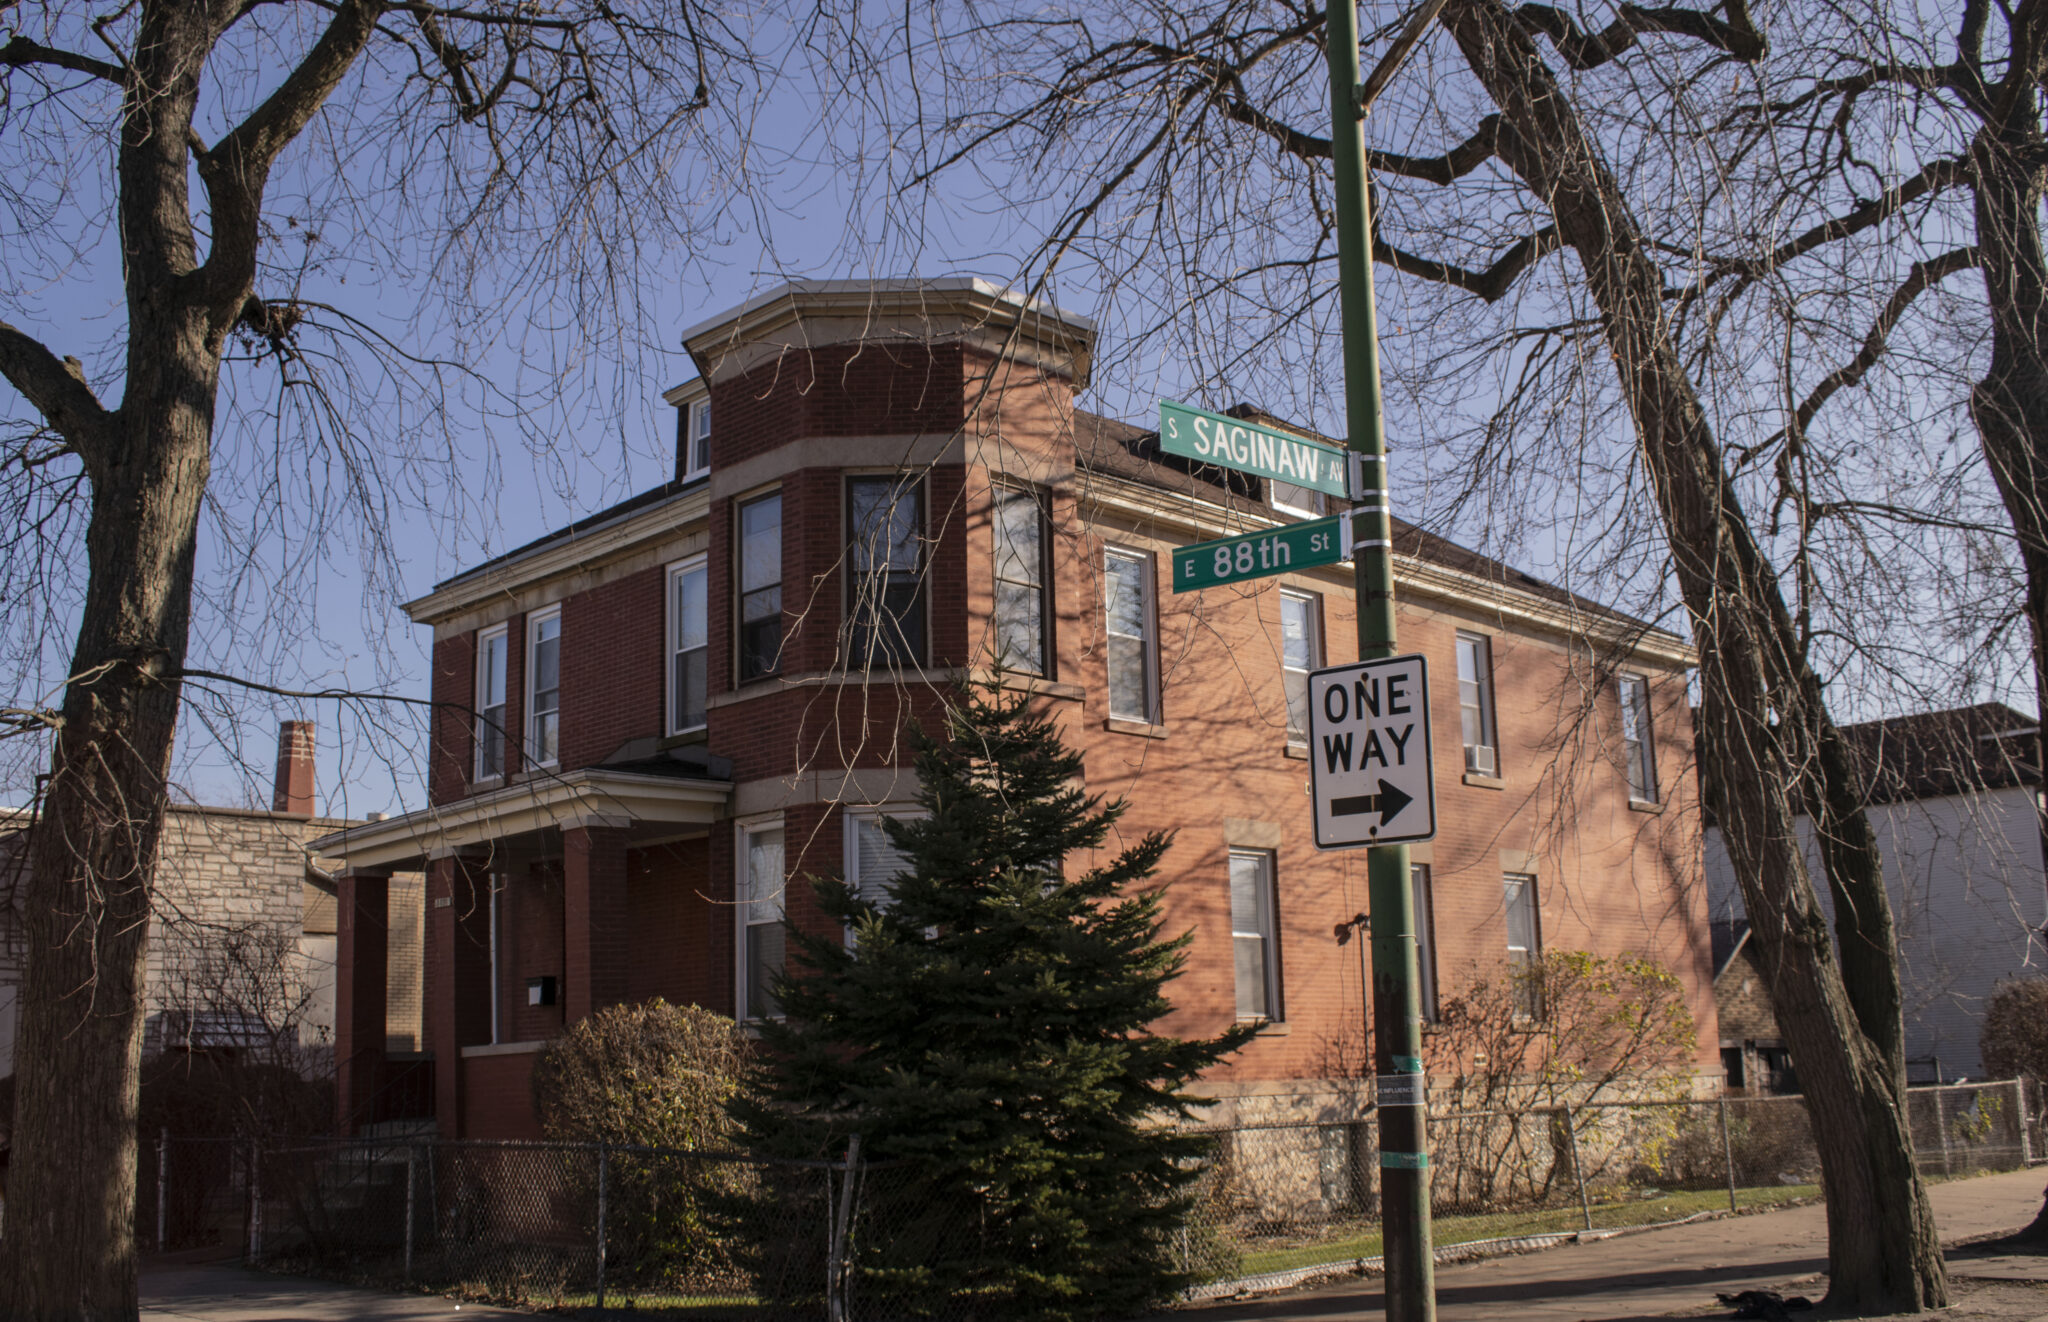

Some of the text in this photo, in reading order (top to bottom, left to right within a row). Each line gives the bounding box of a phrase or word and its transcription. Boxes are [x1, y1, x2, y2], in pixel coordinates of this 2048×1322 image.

[1168, 417, 1178, 439] S
[1193, 416, 1318, 482] SAGINAW
[1185, 532, 1330, 578] E 88th St
[1324, 674, 1411, 724] ONE
[1323, 723, 1415, 774] WAY
